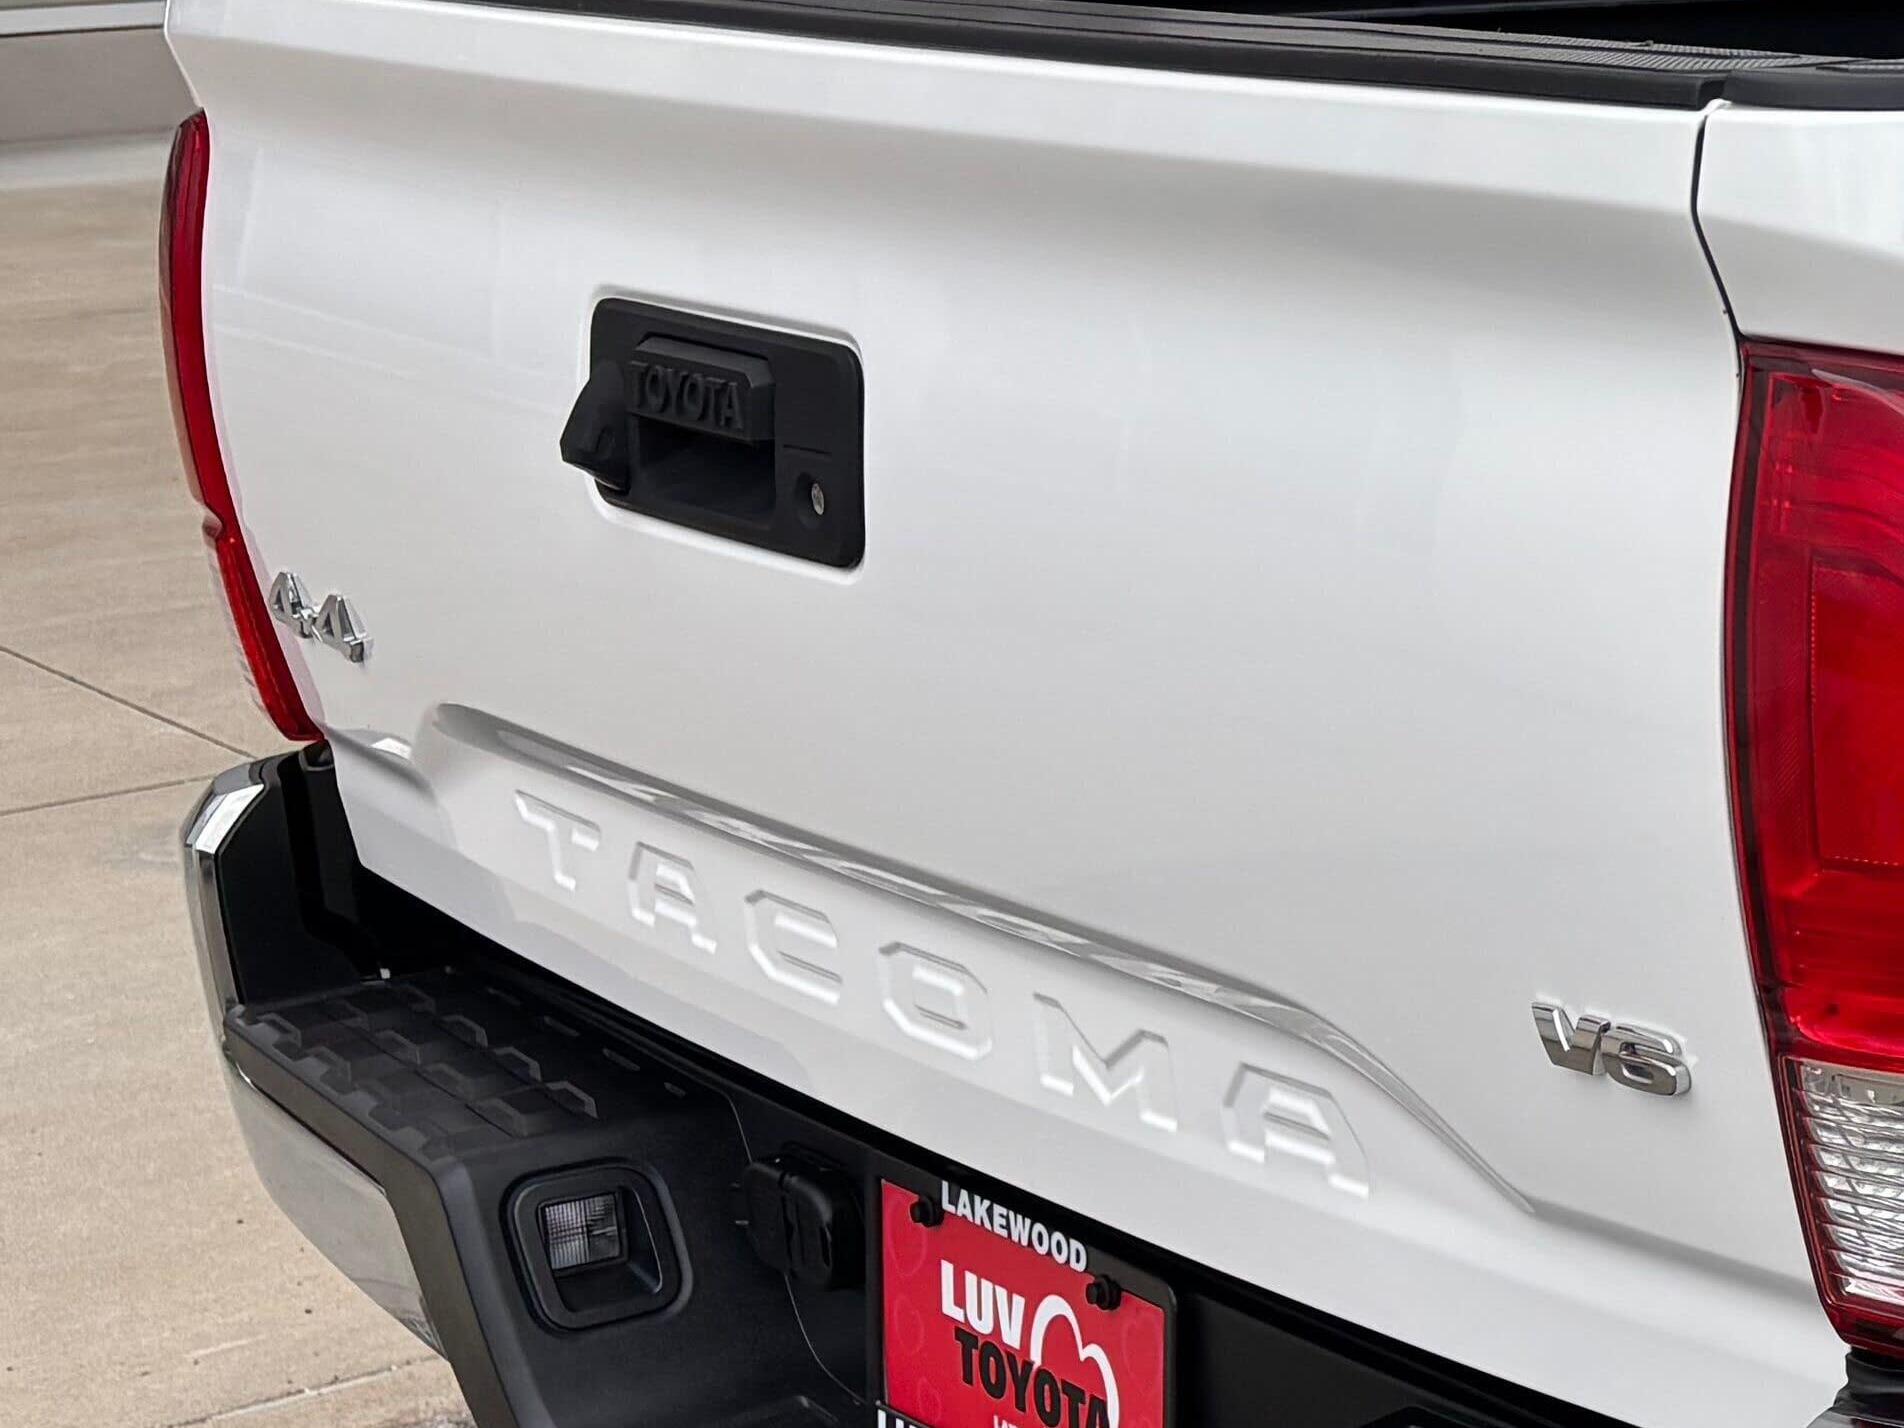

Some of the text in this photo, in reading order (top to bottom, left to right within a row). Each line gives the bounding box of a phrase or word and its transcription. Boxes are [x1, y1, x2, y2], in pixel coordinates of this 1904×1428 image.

[630, 360, 744, 430] TOYOTA
[513, 788, 1371, 1200] TACOMA
[1531, 1001, 1693, 1097] V6
[941, 1180, 1088, 1273] LAKEWOOD
[940, 1259, 1026, 1351] LUV
